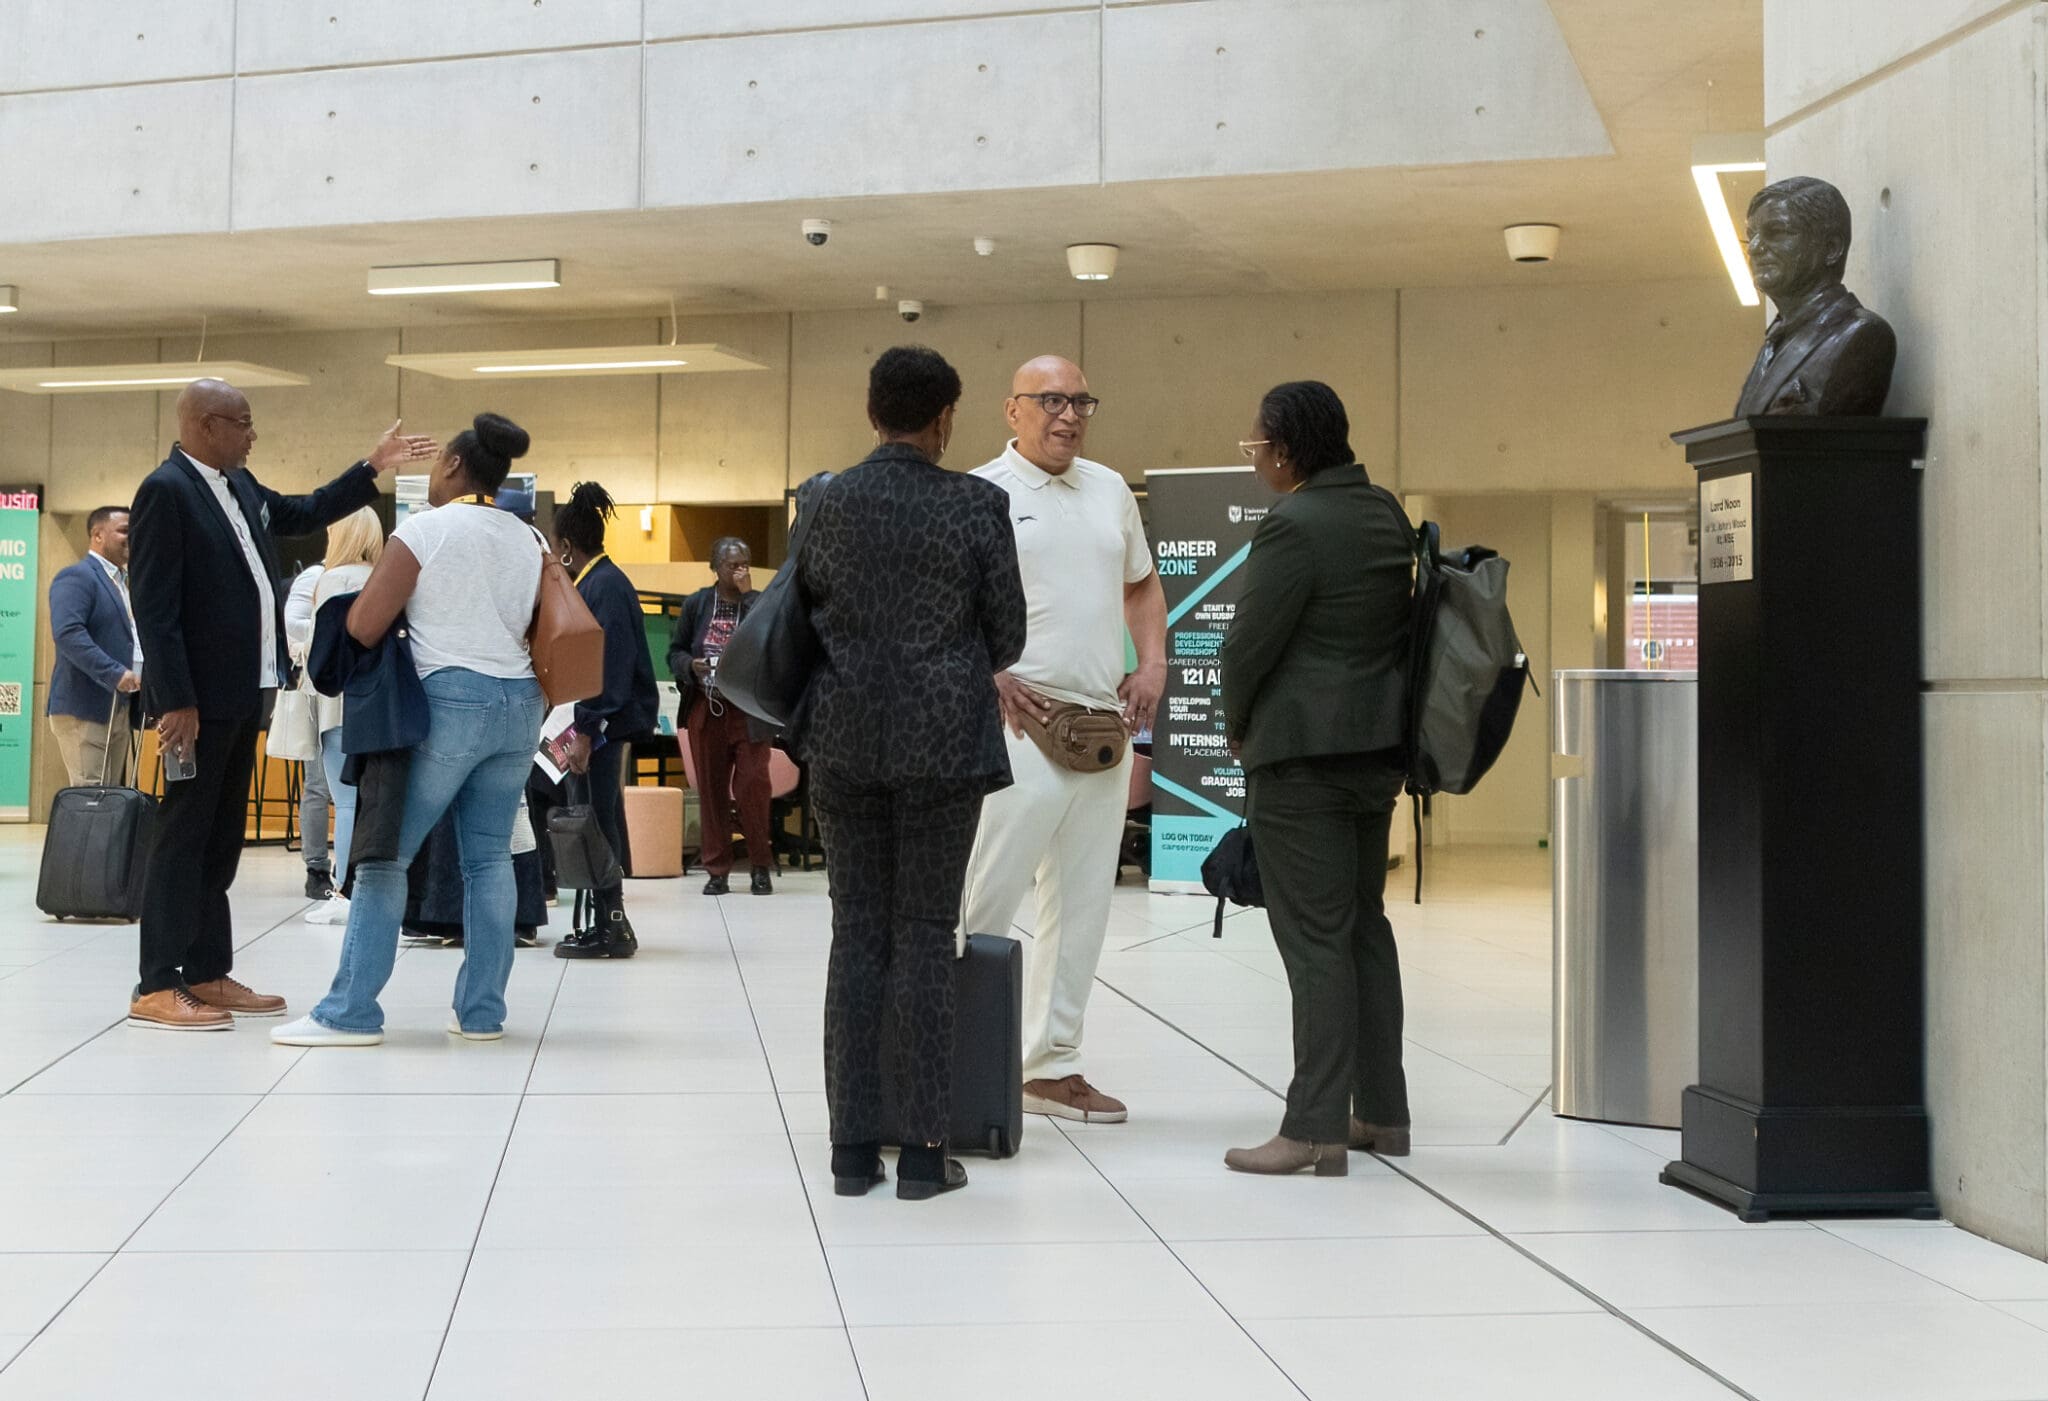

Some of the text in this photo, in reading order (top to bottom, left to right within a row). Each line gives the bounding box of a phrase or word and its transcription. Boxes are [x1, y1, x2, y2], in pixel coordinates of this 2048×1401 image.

[0, 490, 38, 510] usin
[1711, 499, 1741, 512] Lord Noon
[1157, 540, 1217, 557] CAREER
[1158, 559, 1197, 575] ZONE
[1203, 604, 1224, 612] START
[1174, 632, 1225, 640] PROFESSIONAL
[1174, 640, 1223, 648] DEVELOPMENT
[1175, 648, 1217, 656] WORKSHOPS
[1168, 658, 1197, 666] CAREER
[1182, 668, 1221, 685] 121 A
[1169, 697, 1211, 706] DEVELOPING
[1169, 705, 1189, 713] YOUR
[1169, 713, 1207, 721] PORTFOLIO
[1169, 733, 1228, 748] INTERNSH
[1201, 776, 1246, 787] GRADUAT
[1161, 833, 1214, 843] LOG ON TODAY
